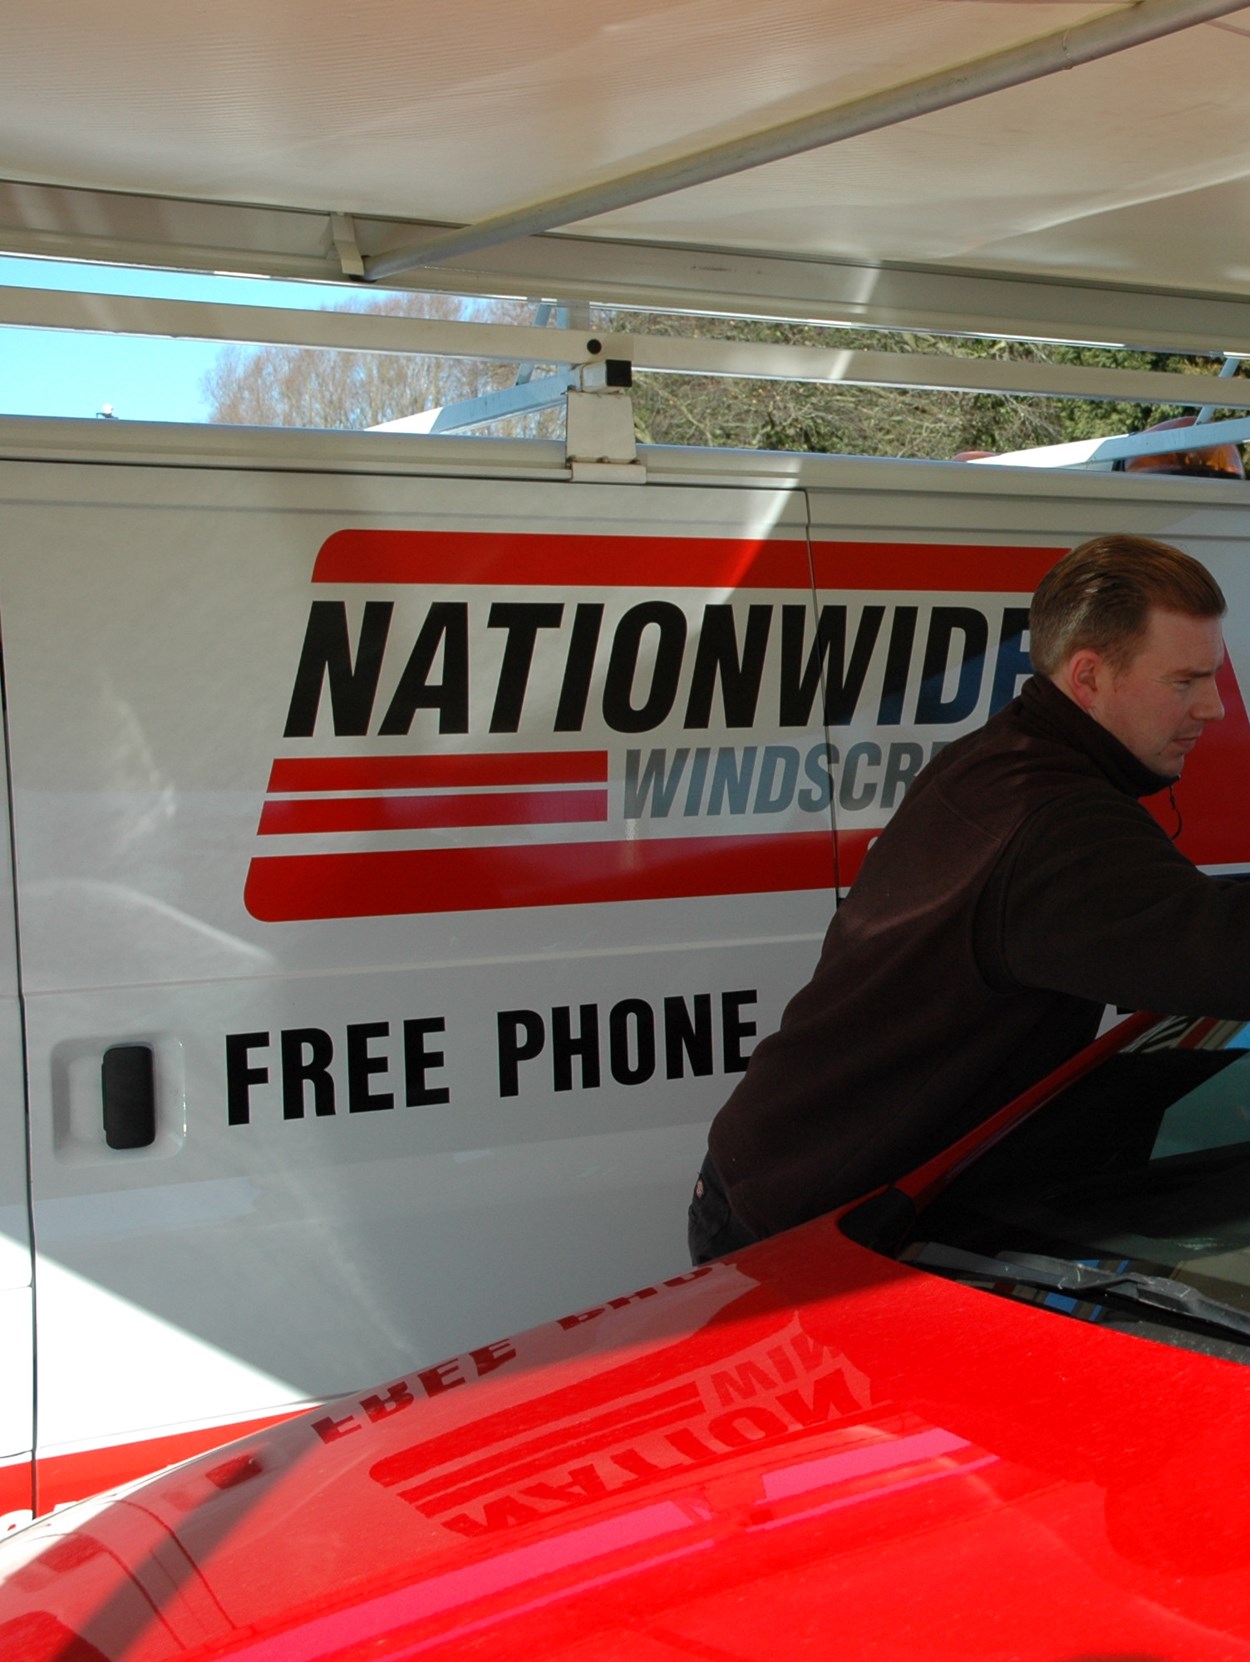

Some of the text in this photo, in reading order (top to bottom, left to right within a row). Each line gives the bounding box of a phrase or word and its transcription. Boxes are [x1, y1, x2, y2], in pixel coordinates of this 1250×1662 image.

[623, 741, 951, 819] WINDSCR
[225, 989, 758, 1127] FREE PHONE
